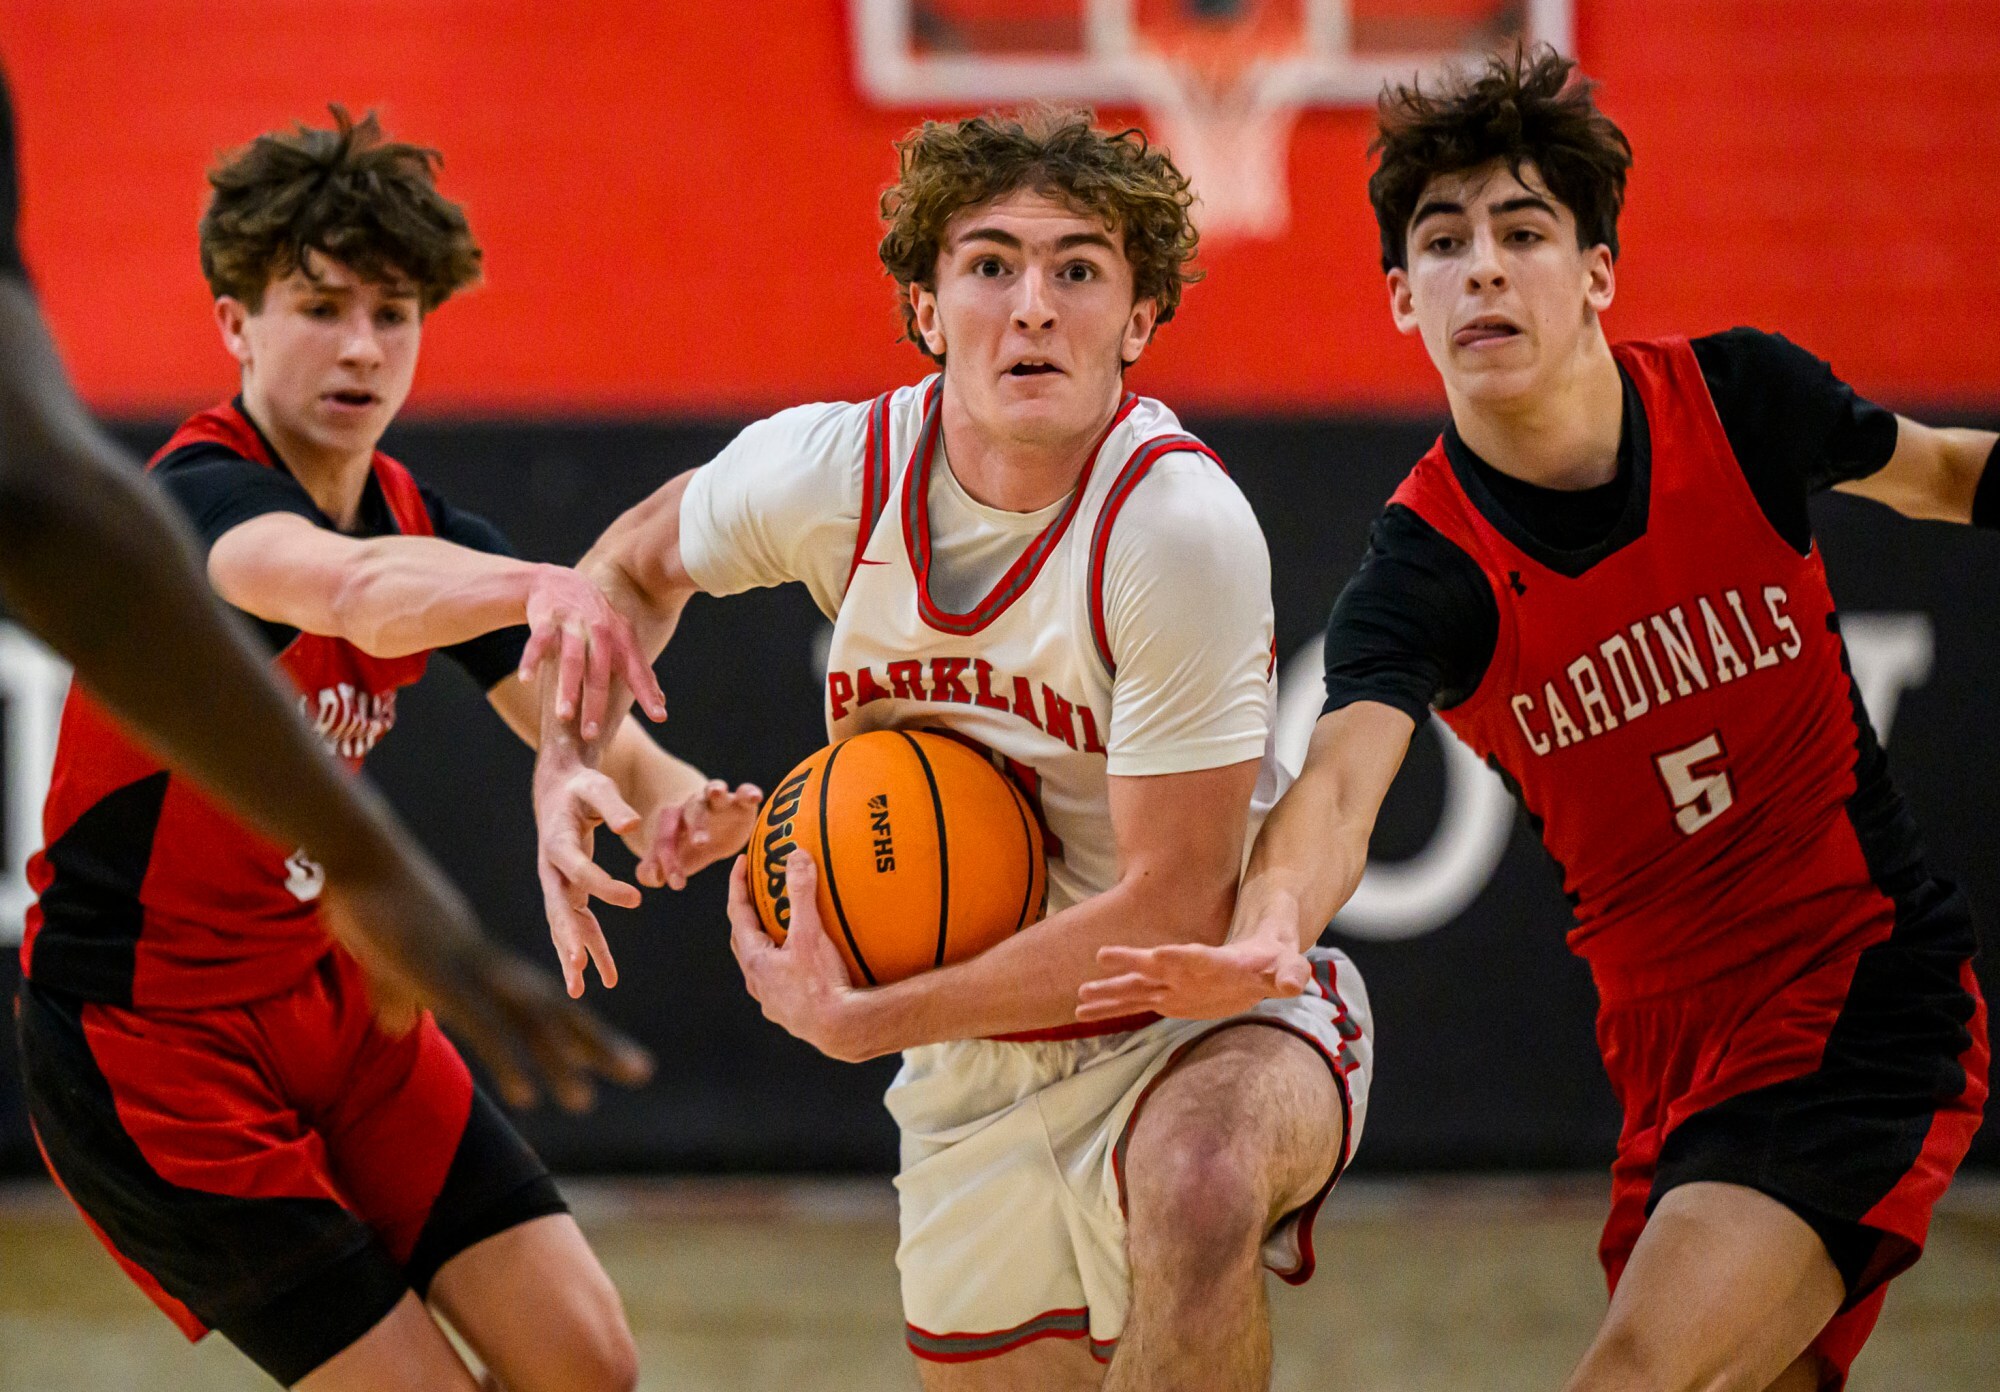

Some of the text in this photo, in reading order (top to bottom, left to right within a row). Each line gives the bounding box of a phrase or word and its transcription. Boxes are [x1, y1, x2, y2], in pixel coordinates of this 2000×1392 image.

[1510, 585, 1803, 757] CARDINALS
[1653, 731, 1736, 837] 5
[869, 810, 896, 874] NFHS
